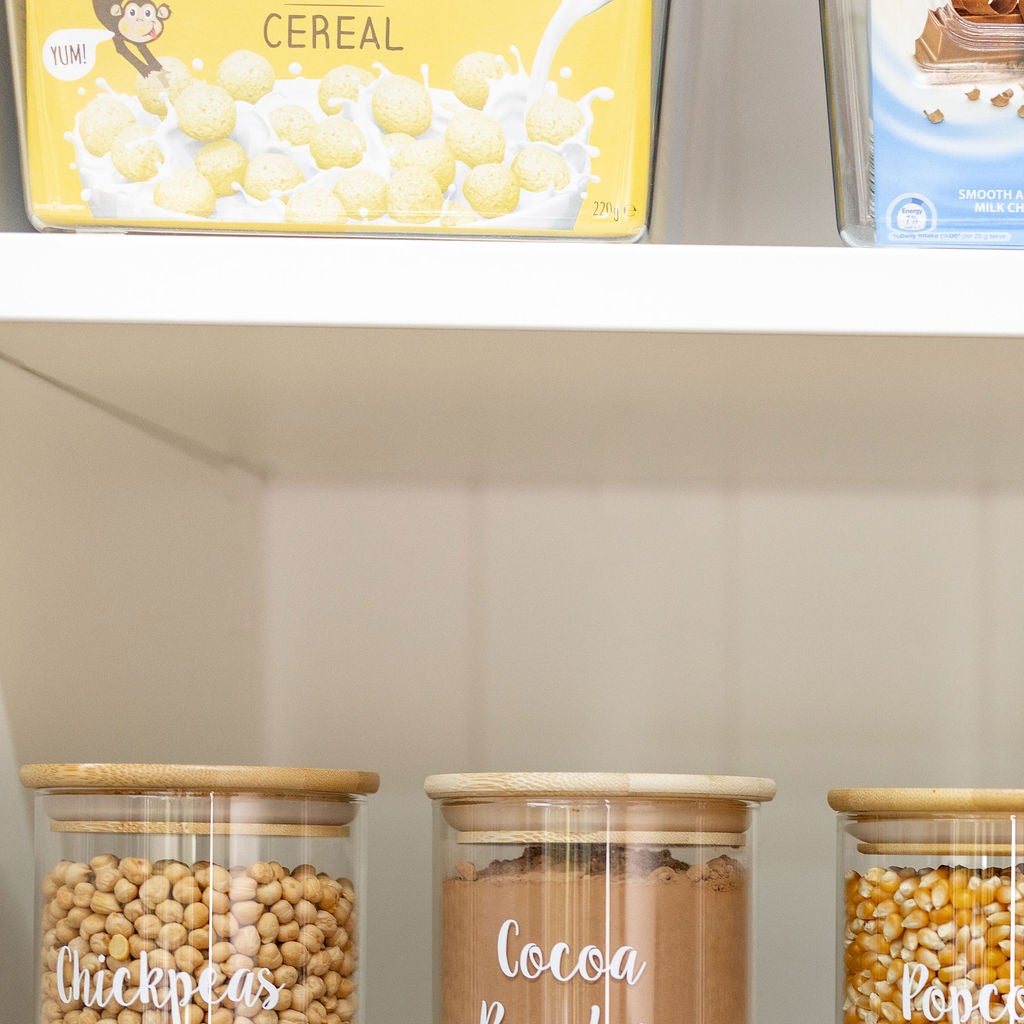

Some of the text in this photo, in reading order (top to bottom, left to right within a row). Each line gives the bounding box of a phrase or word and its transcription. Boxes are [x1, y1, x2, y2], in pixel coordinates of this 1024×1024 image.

[263, 13, 404, 51] CEREAL
[50, 43, 87, 66] YUM!
[958, 189, 1012, 201] SMOOTH
[974, 203, 1004, 213] MILK
[497, 918, 647, 986] Cocoa
